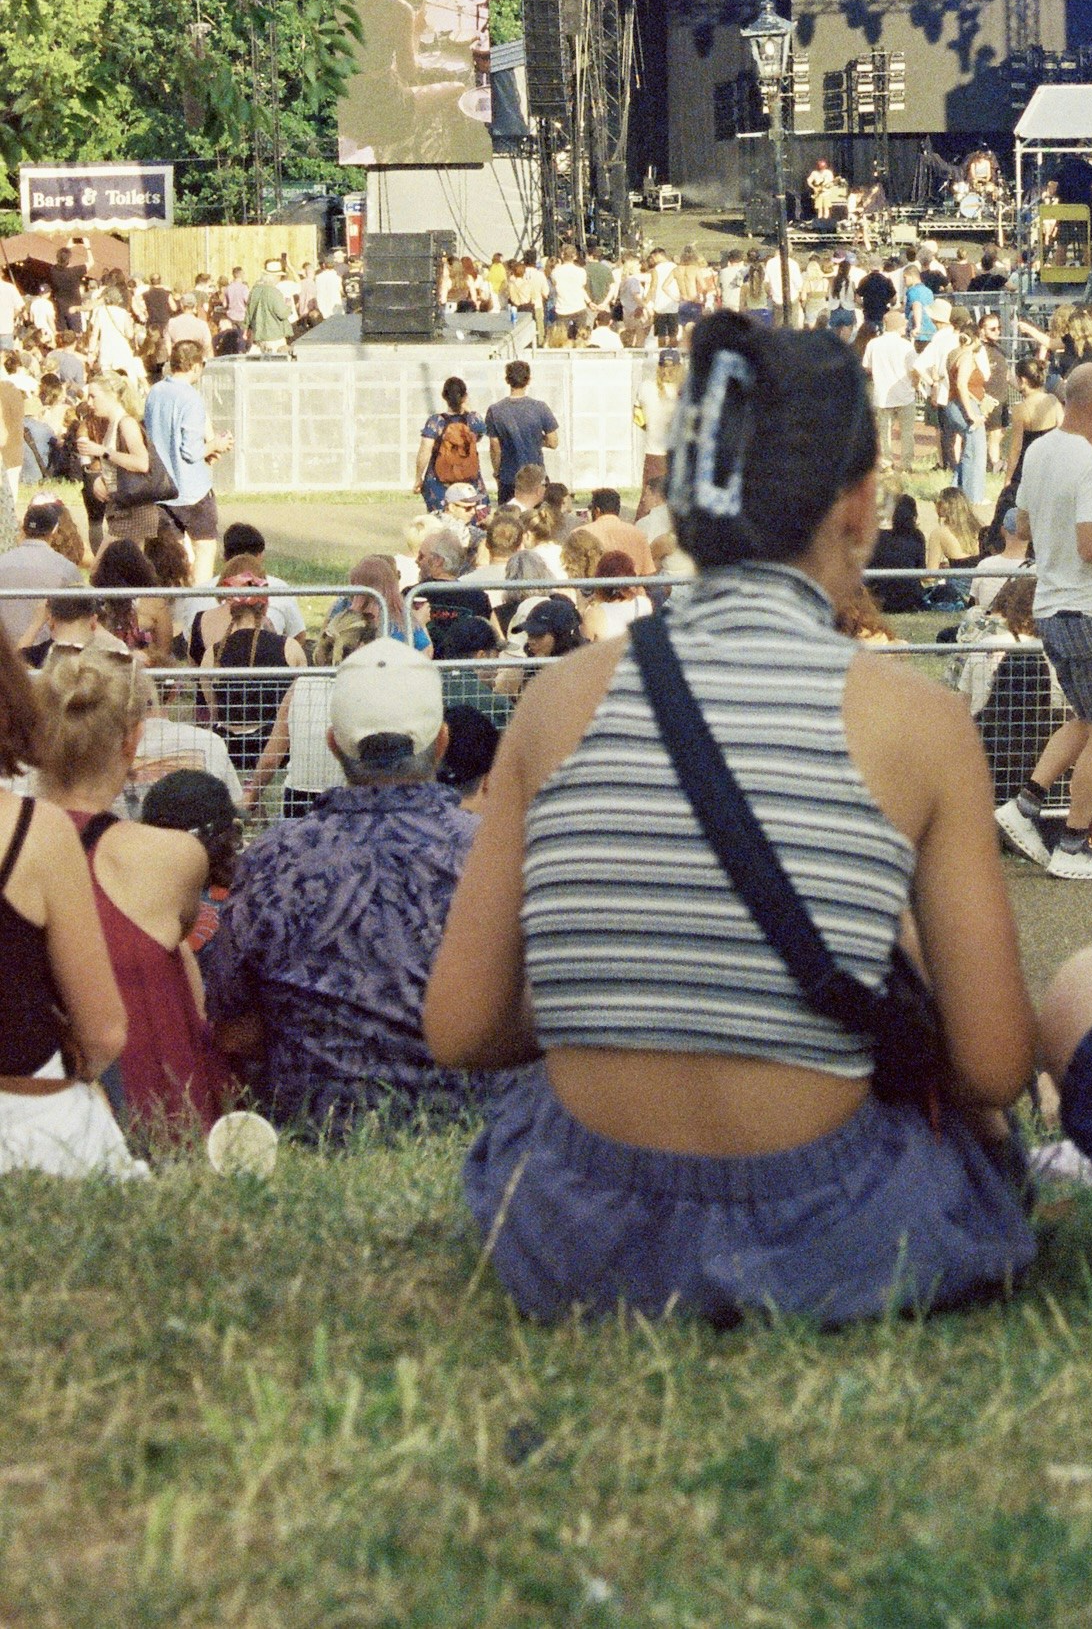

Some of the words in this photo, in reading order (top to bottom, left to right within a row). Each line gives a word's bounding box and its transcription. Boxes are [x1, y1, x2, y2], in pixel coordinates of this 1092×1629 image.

[32, 192, 74, 208] Bars
[81, 187, 98, 206] &
[105, 188, 161, 206] Toilets
